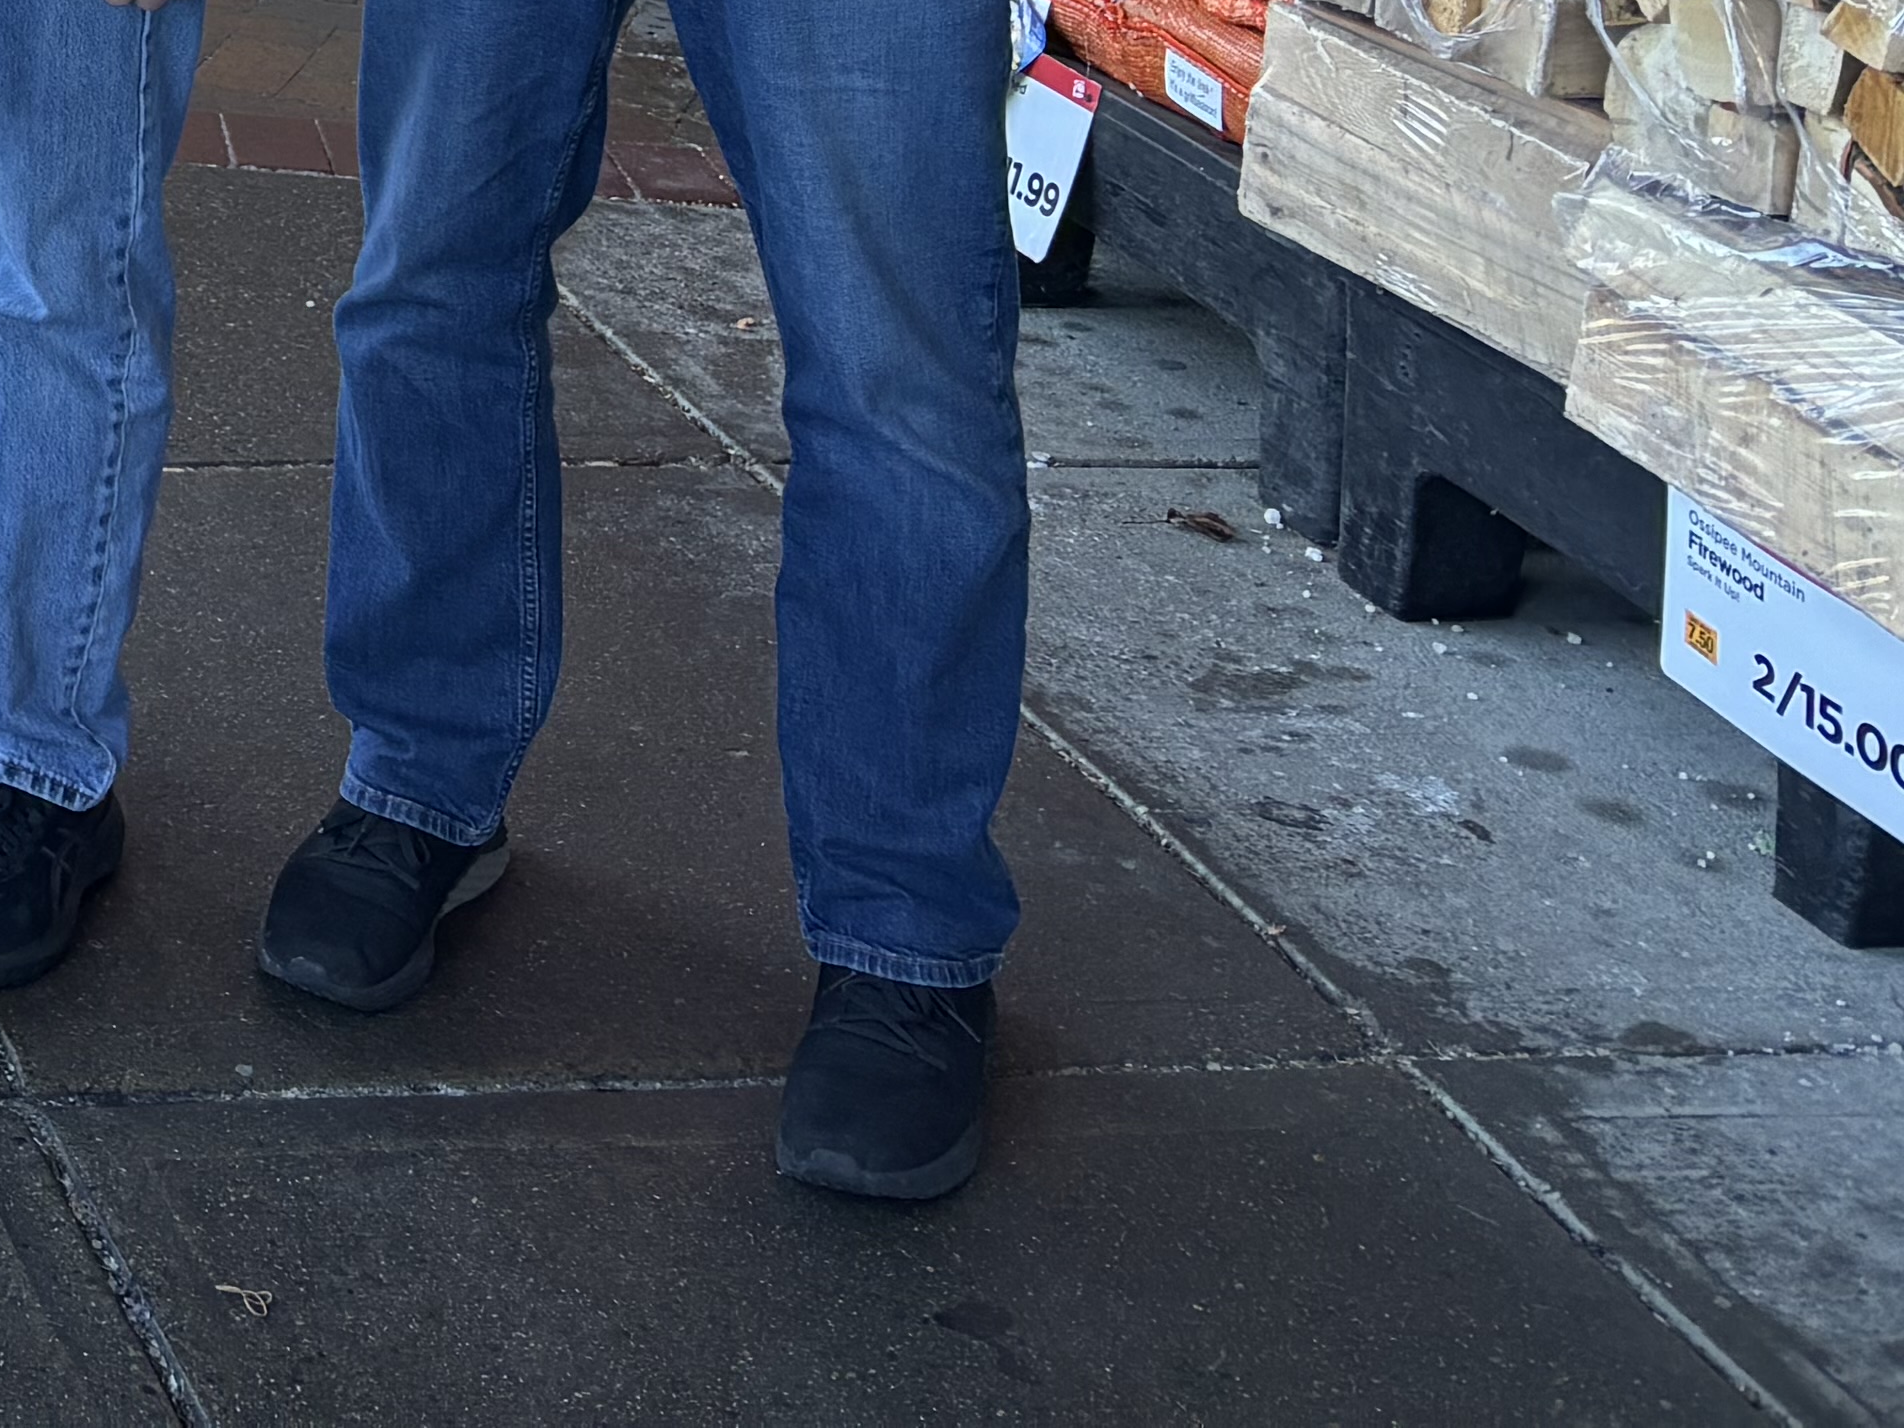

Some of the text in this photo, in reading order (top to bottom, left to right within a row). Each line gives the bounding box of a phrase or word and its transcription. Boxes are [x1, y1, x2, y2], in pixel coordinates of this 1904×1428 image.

[1688, 530, 1764, 602] Firewood
[1689, 509, 1805, 602] Ossipee Mountain
